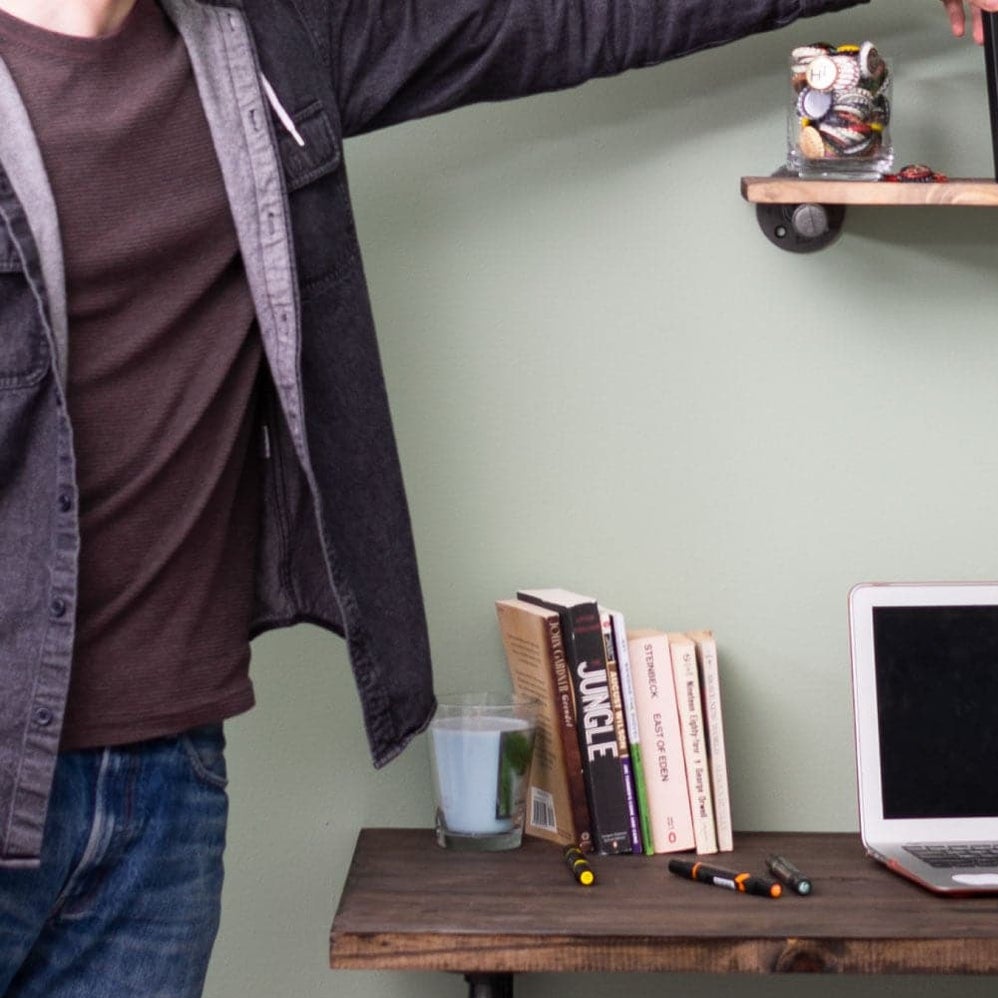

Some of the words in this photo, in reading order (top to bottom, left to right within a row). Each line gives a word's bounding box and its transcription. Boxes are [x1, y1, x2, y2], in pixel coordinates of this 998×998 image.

[644, 643, 658, 699] STEINBECK
[610, 669, 622, 709] AUGUST
[561, 693, 574, 728] Grendel
[576, 660, 620, 763] JUNGLE
[653, 713, 664, 738] EAST
[615, 710, 627, 750] WILSON
[657, 740, 667, 754] OF
[659, 755, 669, 782] EDEN
[695, 764, 704, 793] George
